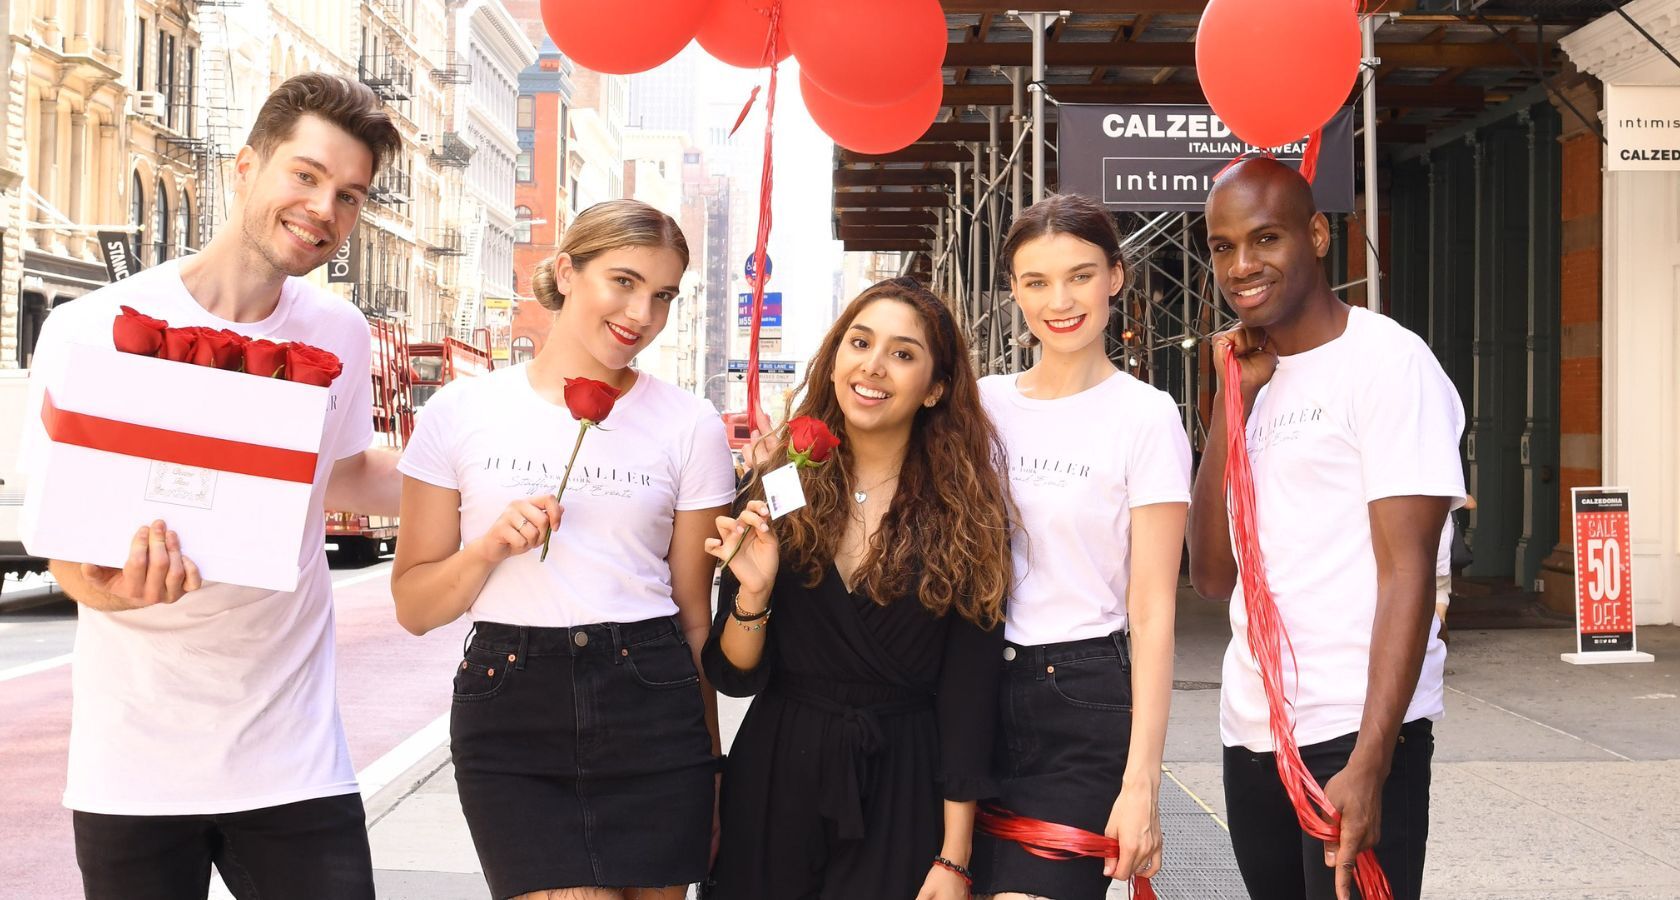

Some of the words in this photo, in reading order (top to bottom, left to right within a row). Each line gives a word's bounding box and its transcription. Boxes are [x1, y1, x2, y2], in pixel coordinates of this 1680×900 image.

[1102, 113, 1310, 139] CALZED
[1188, 142, 1241, 153] ITALIAN
[565, 464, 651, 487] ALLER
[1581, 497, 1623, 505] CALZEDONIA
[1588, 519, 1618, 538] SALE
[1587, 538, 1621, 601] 50
[1593, 602, 1621, 626] OFF
